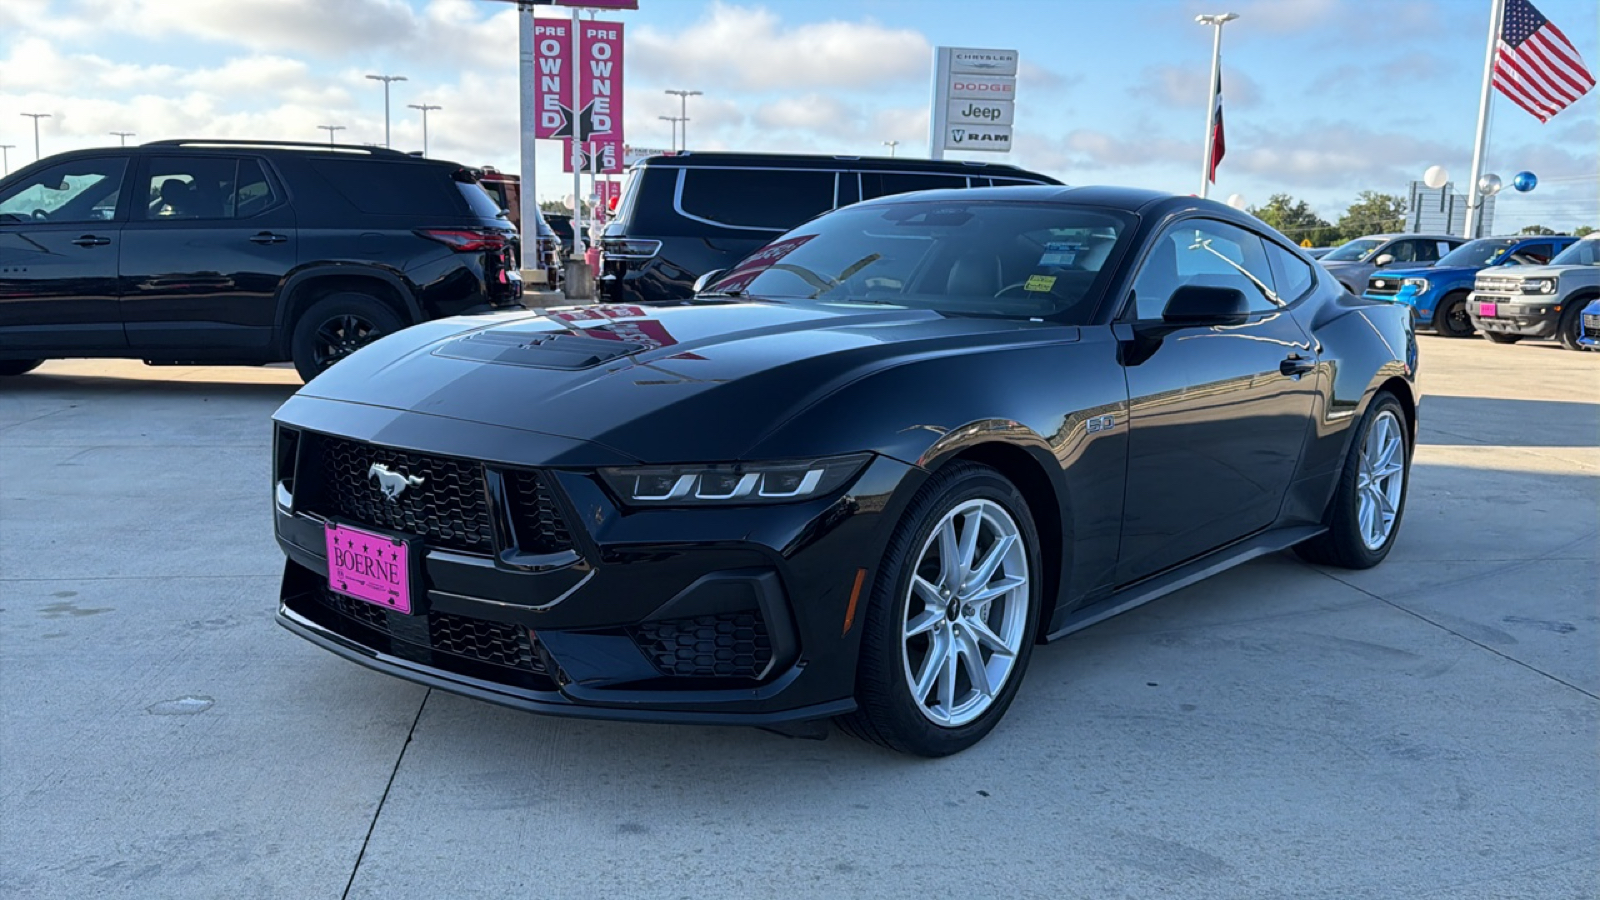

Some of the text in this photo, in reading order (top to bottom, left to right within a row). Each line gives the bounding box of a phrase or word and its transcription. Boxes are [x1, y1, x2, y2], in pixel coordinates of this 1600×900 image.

[535, 26, 565, 36] PRE
[587, 29, 617, 40] PRE
[539, 39, 562, 128] OWNED
[590, 42, 613, 131] OWNED
[954, 82, 1011, 92] DODGE
[962, 103, 1001, 121] Jeep
[968, 133, 1009, 142] RAM
[334, 546, 400, 585] BOERNE
